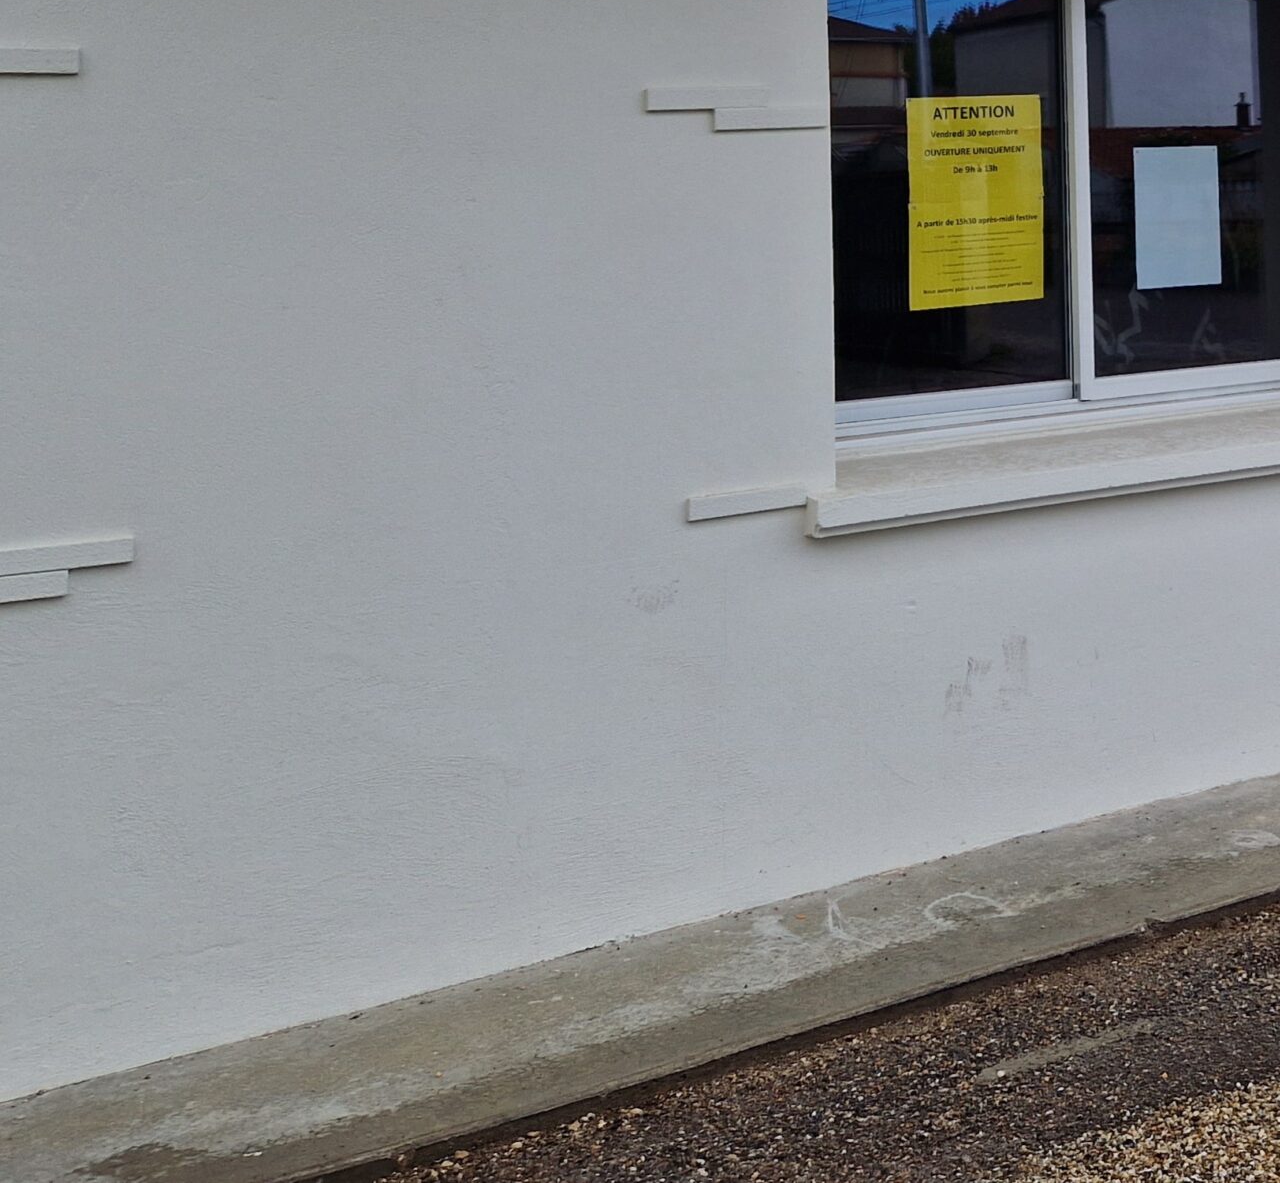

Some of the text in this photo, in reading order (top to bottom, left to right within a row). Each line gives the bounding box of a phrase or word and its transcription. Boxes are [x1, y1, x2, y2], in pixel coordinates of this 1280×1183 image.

[933, 105, 1015, 120] ATTENTION
[930, 128, 1019, 138] Vendredi 30 septembre
[924, 145, 1026, 157] OUVERTURE UNIQUEMENT
[953, 164, 998, 174] De 9h à 13h
[924, 220, 944, 229] partir
[945, 219, 954, 227] de
[978, 215, 1015, 226] après-midi
